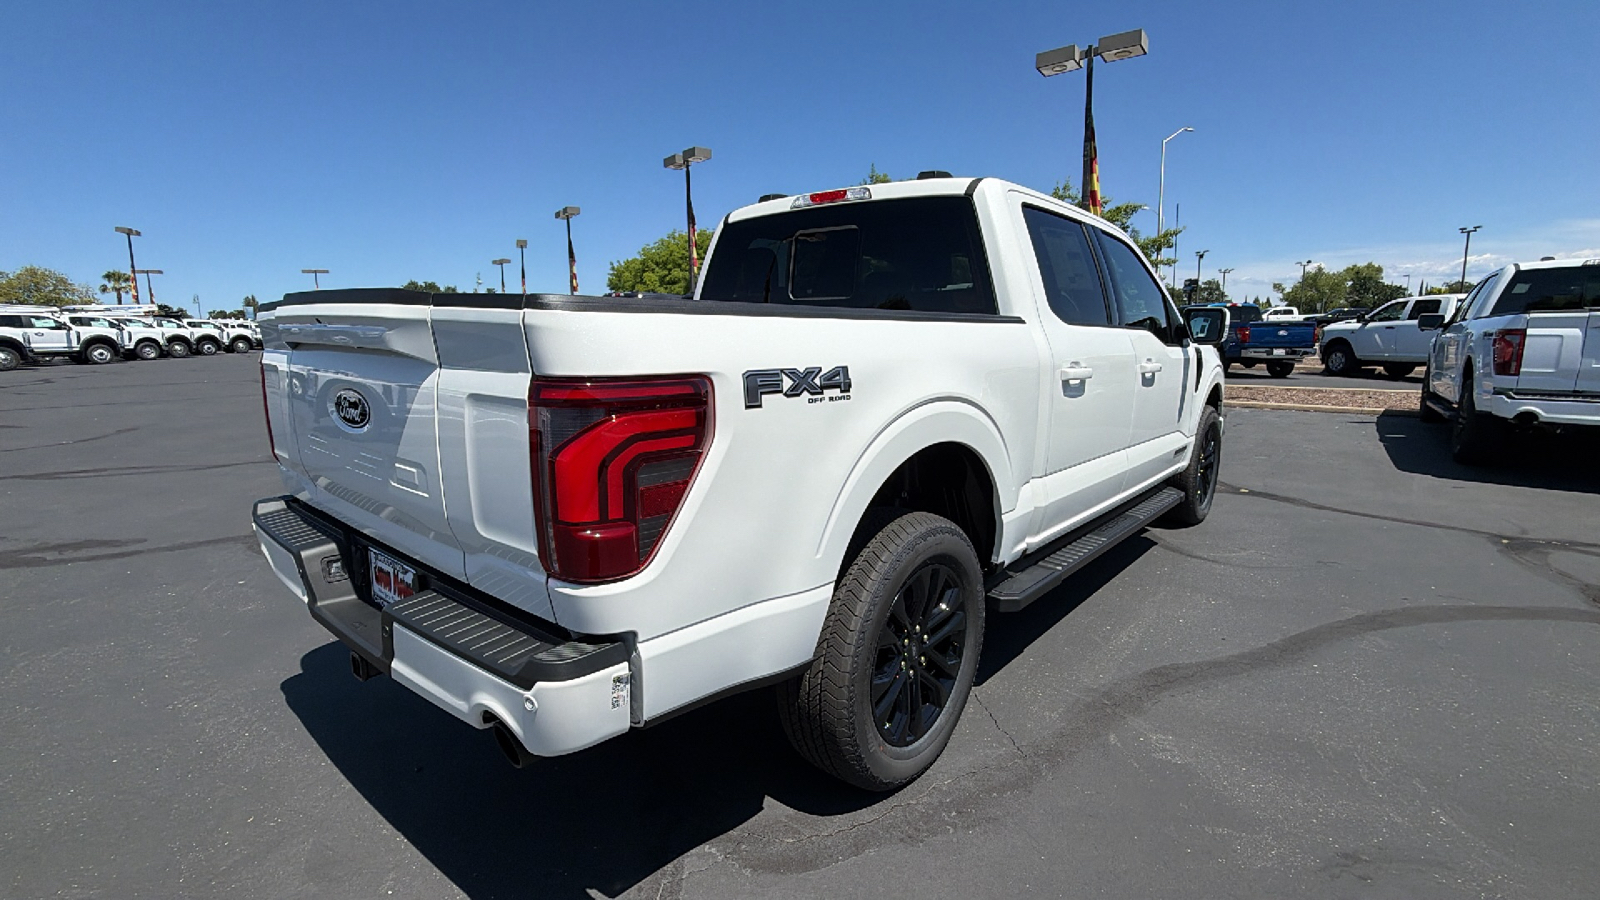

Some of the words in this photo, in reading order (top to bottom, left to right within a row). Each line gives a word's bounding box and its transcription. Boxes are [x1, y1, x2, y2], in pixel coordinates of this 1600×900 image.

[742, 365, 852, 410] FX4
[829, 394, 852, 403] ROAD
[338, 394, 361, 422] Ford
